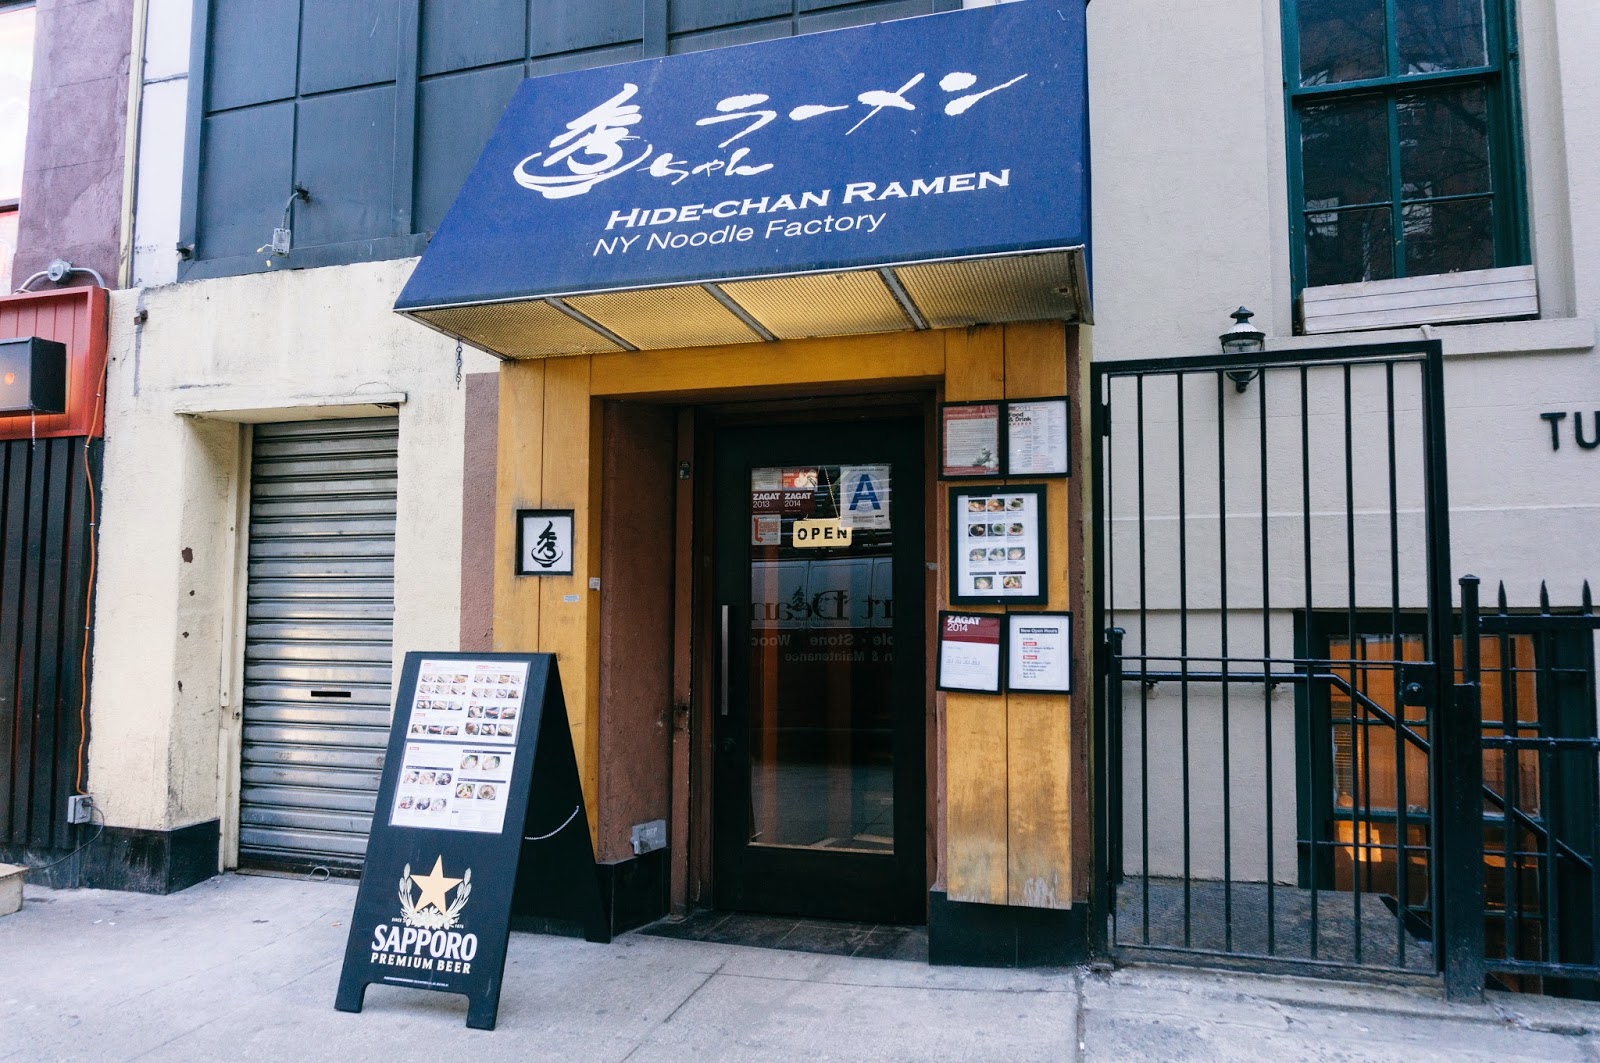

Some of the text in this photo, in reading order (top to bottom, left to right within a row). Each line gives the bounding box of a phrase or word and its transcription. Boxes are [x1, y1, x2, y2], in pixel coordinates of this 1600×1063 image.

[696, 72, 1028, 148] ラーメン
[604, 168, 1011, 230] HIDE-CHAN RAMEN
[592, 211, 887, 256] NY Noodle Factory
[849, 474, 881, 510] A
[797, 527, 848, 540] OPEN
[947, 615, 981, 625] ZAGAT
[947, 623, 968, 632] 2014
[371, 924, 478, 961] SAPPORO
[370, 952, 471, 974] PREMIUM BEER
